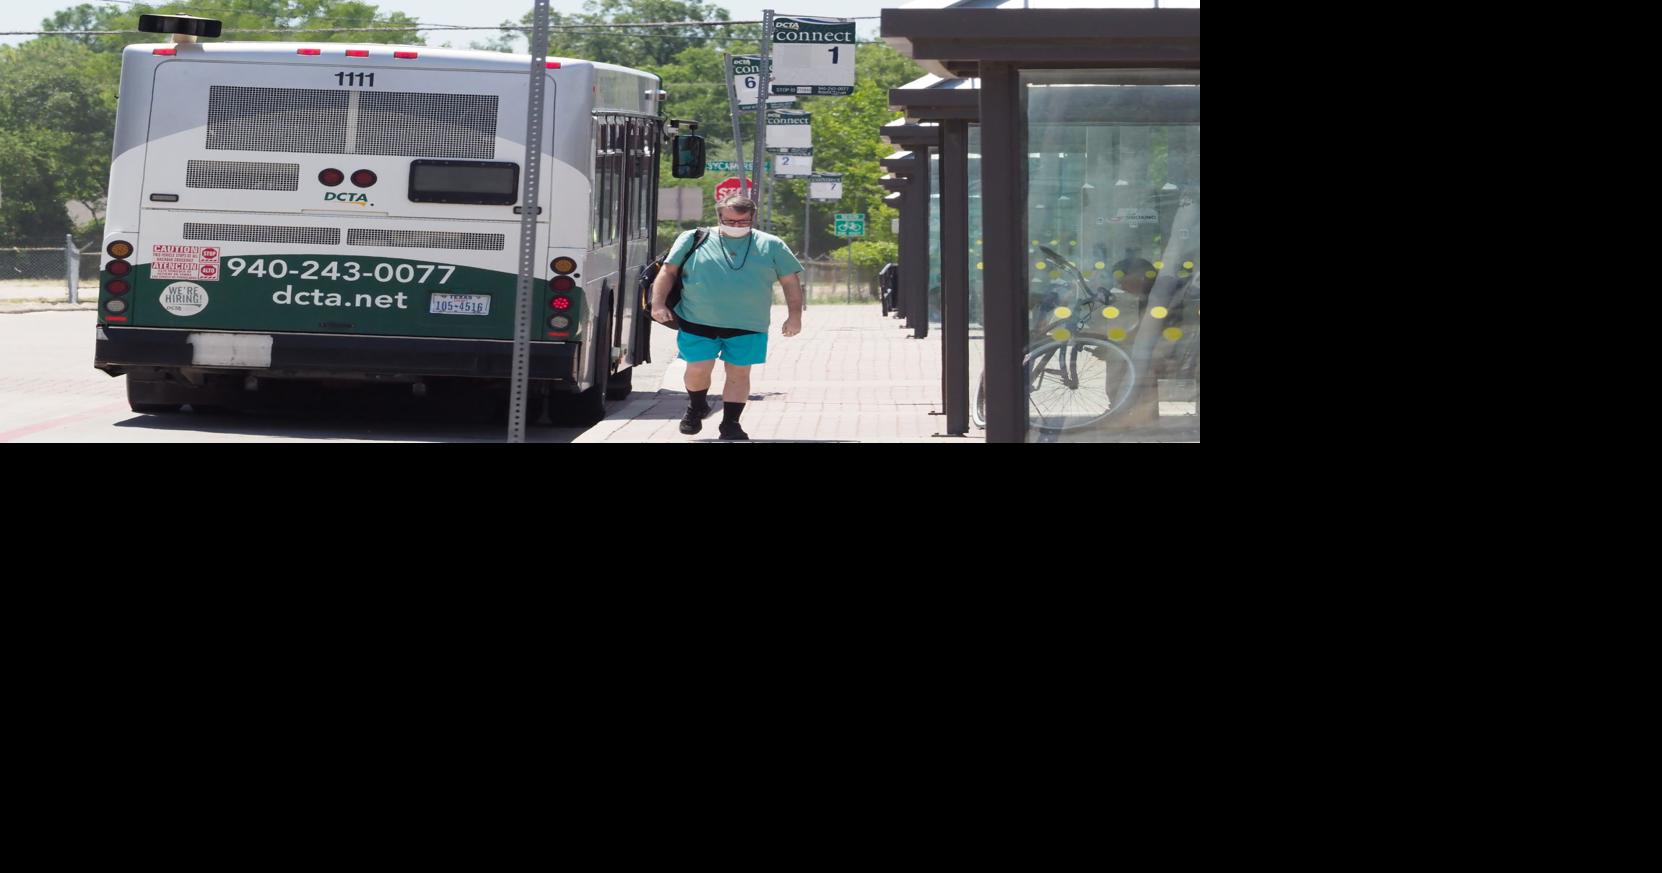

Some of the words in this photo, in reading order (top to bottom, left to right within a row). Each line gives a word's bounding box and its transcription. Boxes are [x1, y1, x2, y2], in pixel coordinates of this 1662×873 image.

[776, 30, 851, 42] connect
[828, 46, 839, 64] 1
[334, 71, 375, 87] 1111
[744, 76, 757, 89] 6
[782, 156, 790, 166] 2
[324, 192, 368, 202] DCTA
[153, 245, 198, 253] CAUTION
[152, 262, 198, 270] ATENCION
[227, 257, 456, 285] 940-243-0077
[168, 286, 199, 295] WE'RE
[165, 294, 202, 304] HIRING!
[272, 285, 408, 309] dcta.net
[436, 301, 484, 312] 105-4516
